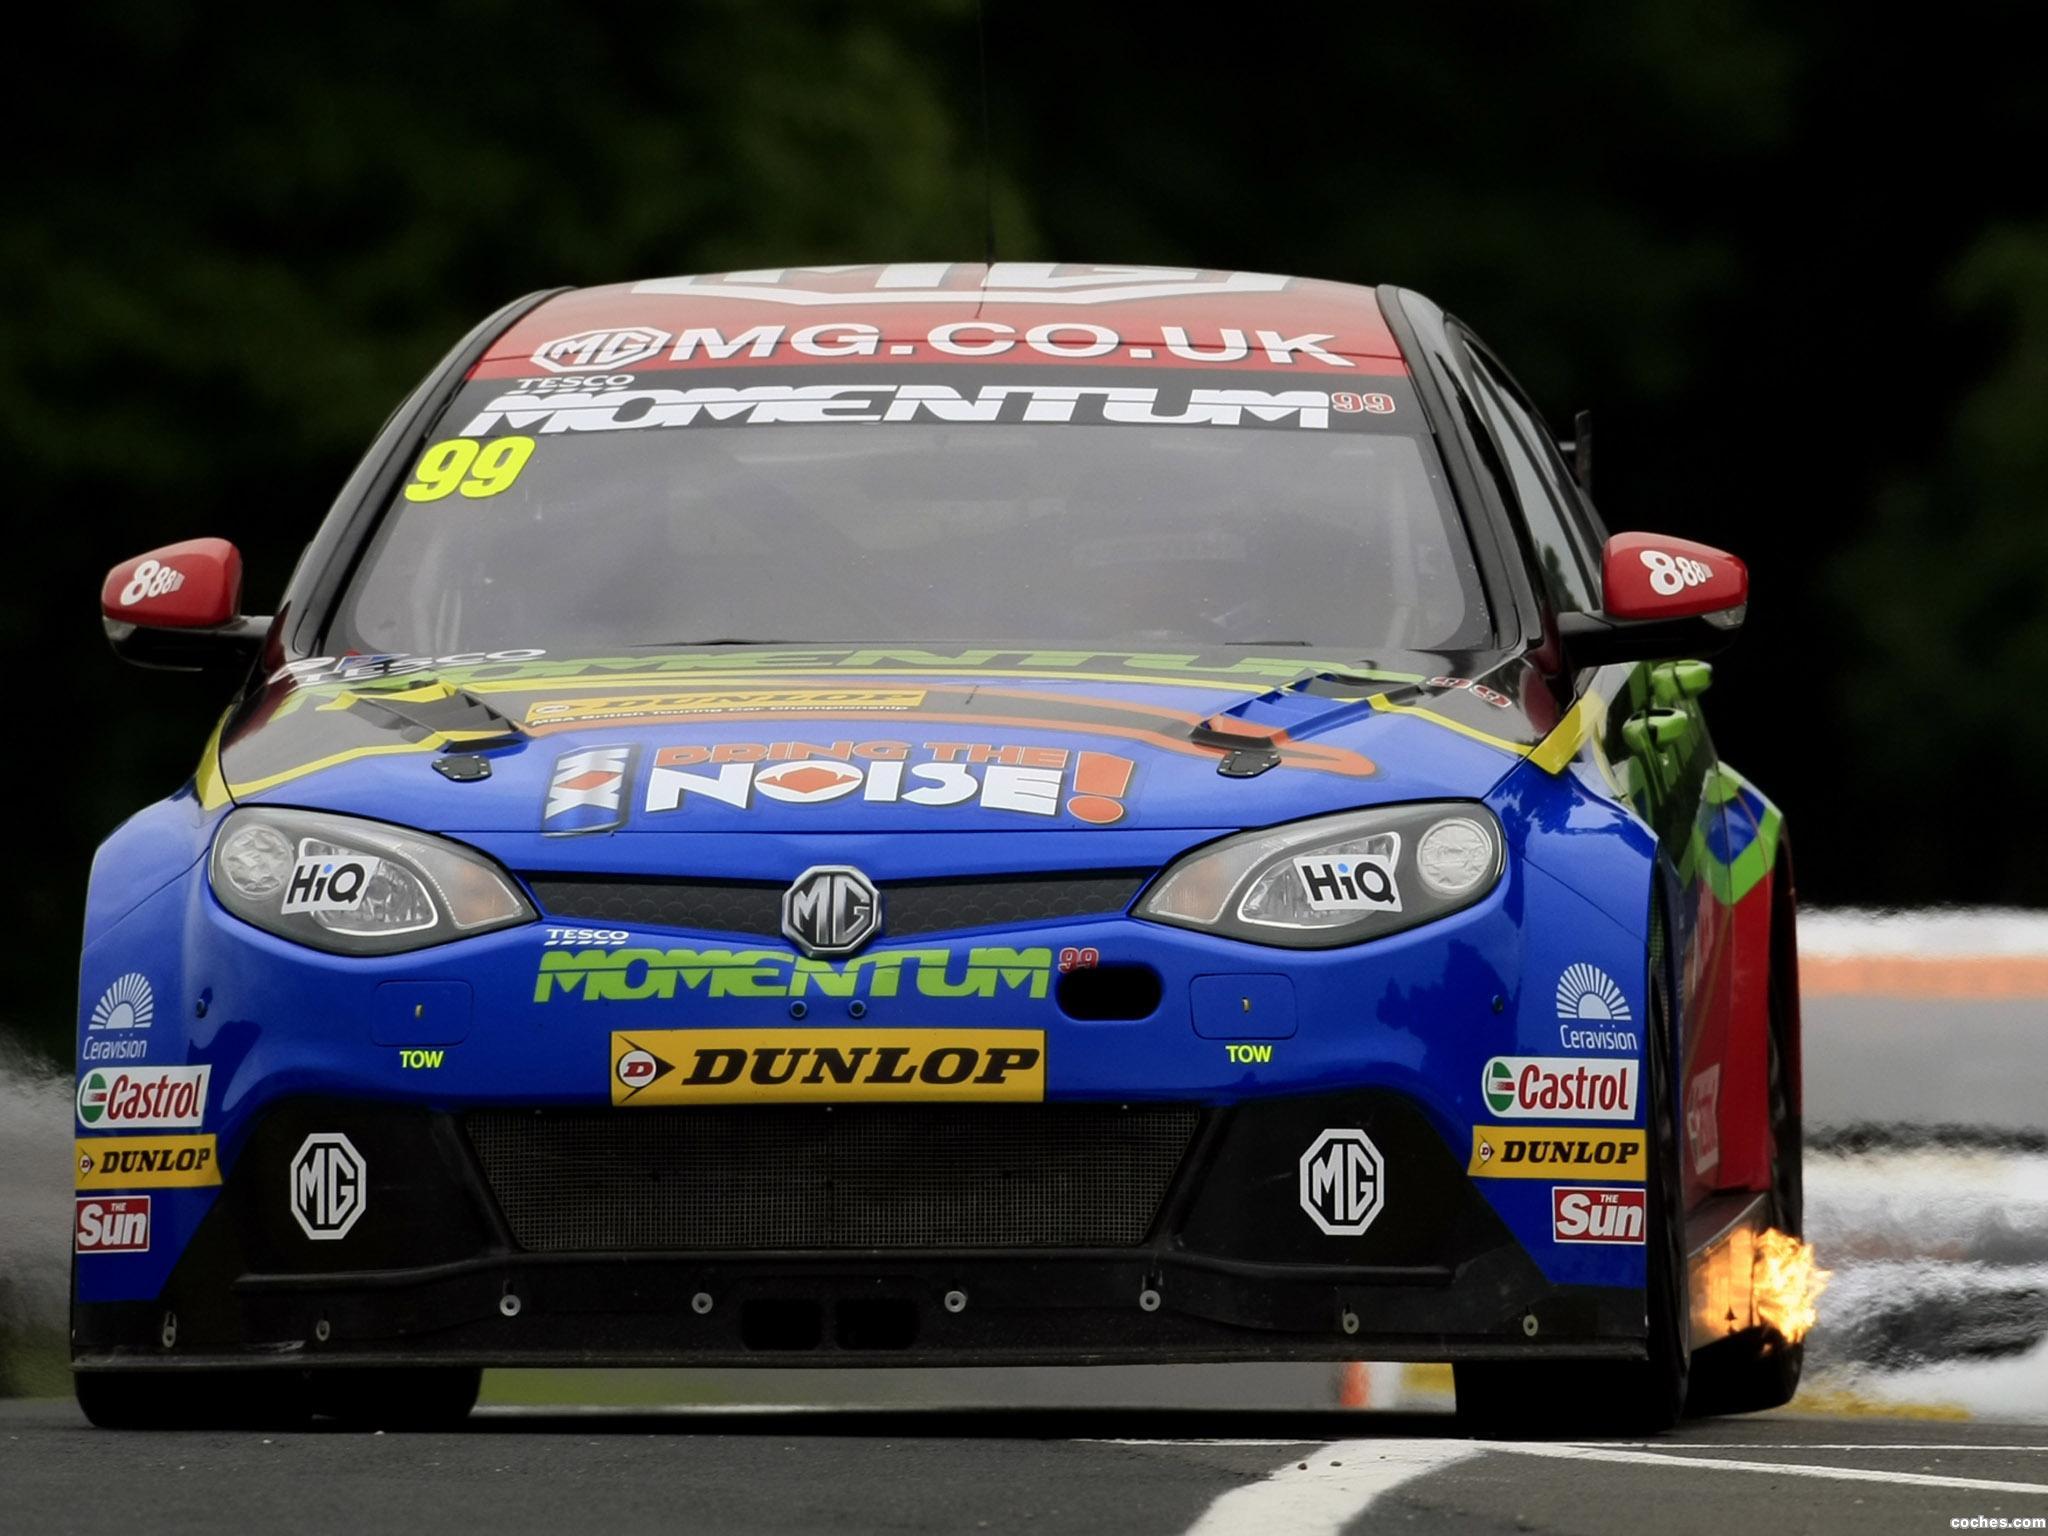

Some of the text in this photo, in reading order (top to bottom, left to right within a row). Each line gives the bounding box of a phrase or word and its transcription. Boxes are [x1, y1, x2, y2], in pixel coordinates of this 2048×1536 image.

[545, 322, 1356, 367] MG MG.CO.UK
[515, 374, 636, 390] TESCO
[459, 385, 1396, 437] MOMENTUM 99
[404, 435, 536, 502] 99
[922, 741, 1070, 769] THE
[285, 862, 366, 904] HiQ
[1301, 861, 1396, 904] HiQ
[790, 868, 874, 947] MG
[545, 928, 630, 941] TESCO
[533, 947, 1100, 1002] MOMENTUM 99
[82, 1034, 148, 1061] Ceravision
[1225, 1045, 1273, 1064] TOW
[1559, 1023, 1638, 1051] Ceravision
[399, 1050, 444, 1069] TOW
[682, 1047, 1041, 1086] DUNLOP
[107, 1073, 203, 1121] Castrol
[1518, 1063, 1630, 1111] Castrol
[100, 1148, 212, 1174] DUNLOP
[1500, 1140, 1640, 1164] DUNLOP
[297, 1146, 357, 1227] MG
[1309, 1141, 1376, 1223] MG
[1600, 1193, 1620, 1204] THE
[78, 1203, 148, 1247] Sun
[111, 1202, 127, 1212] THE
[1556, 1193, 1644, 1238] Sun
